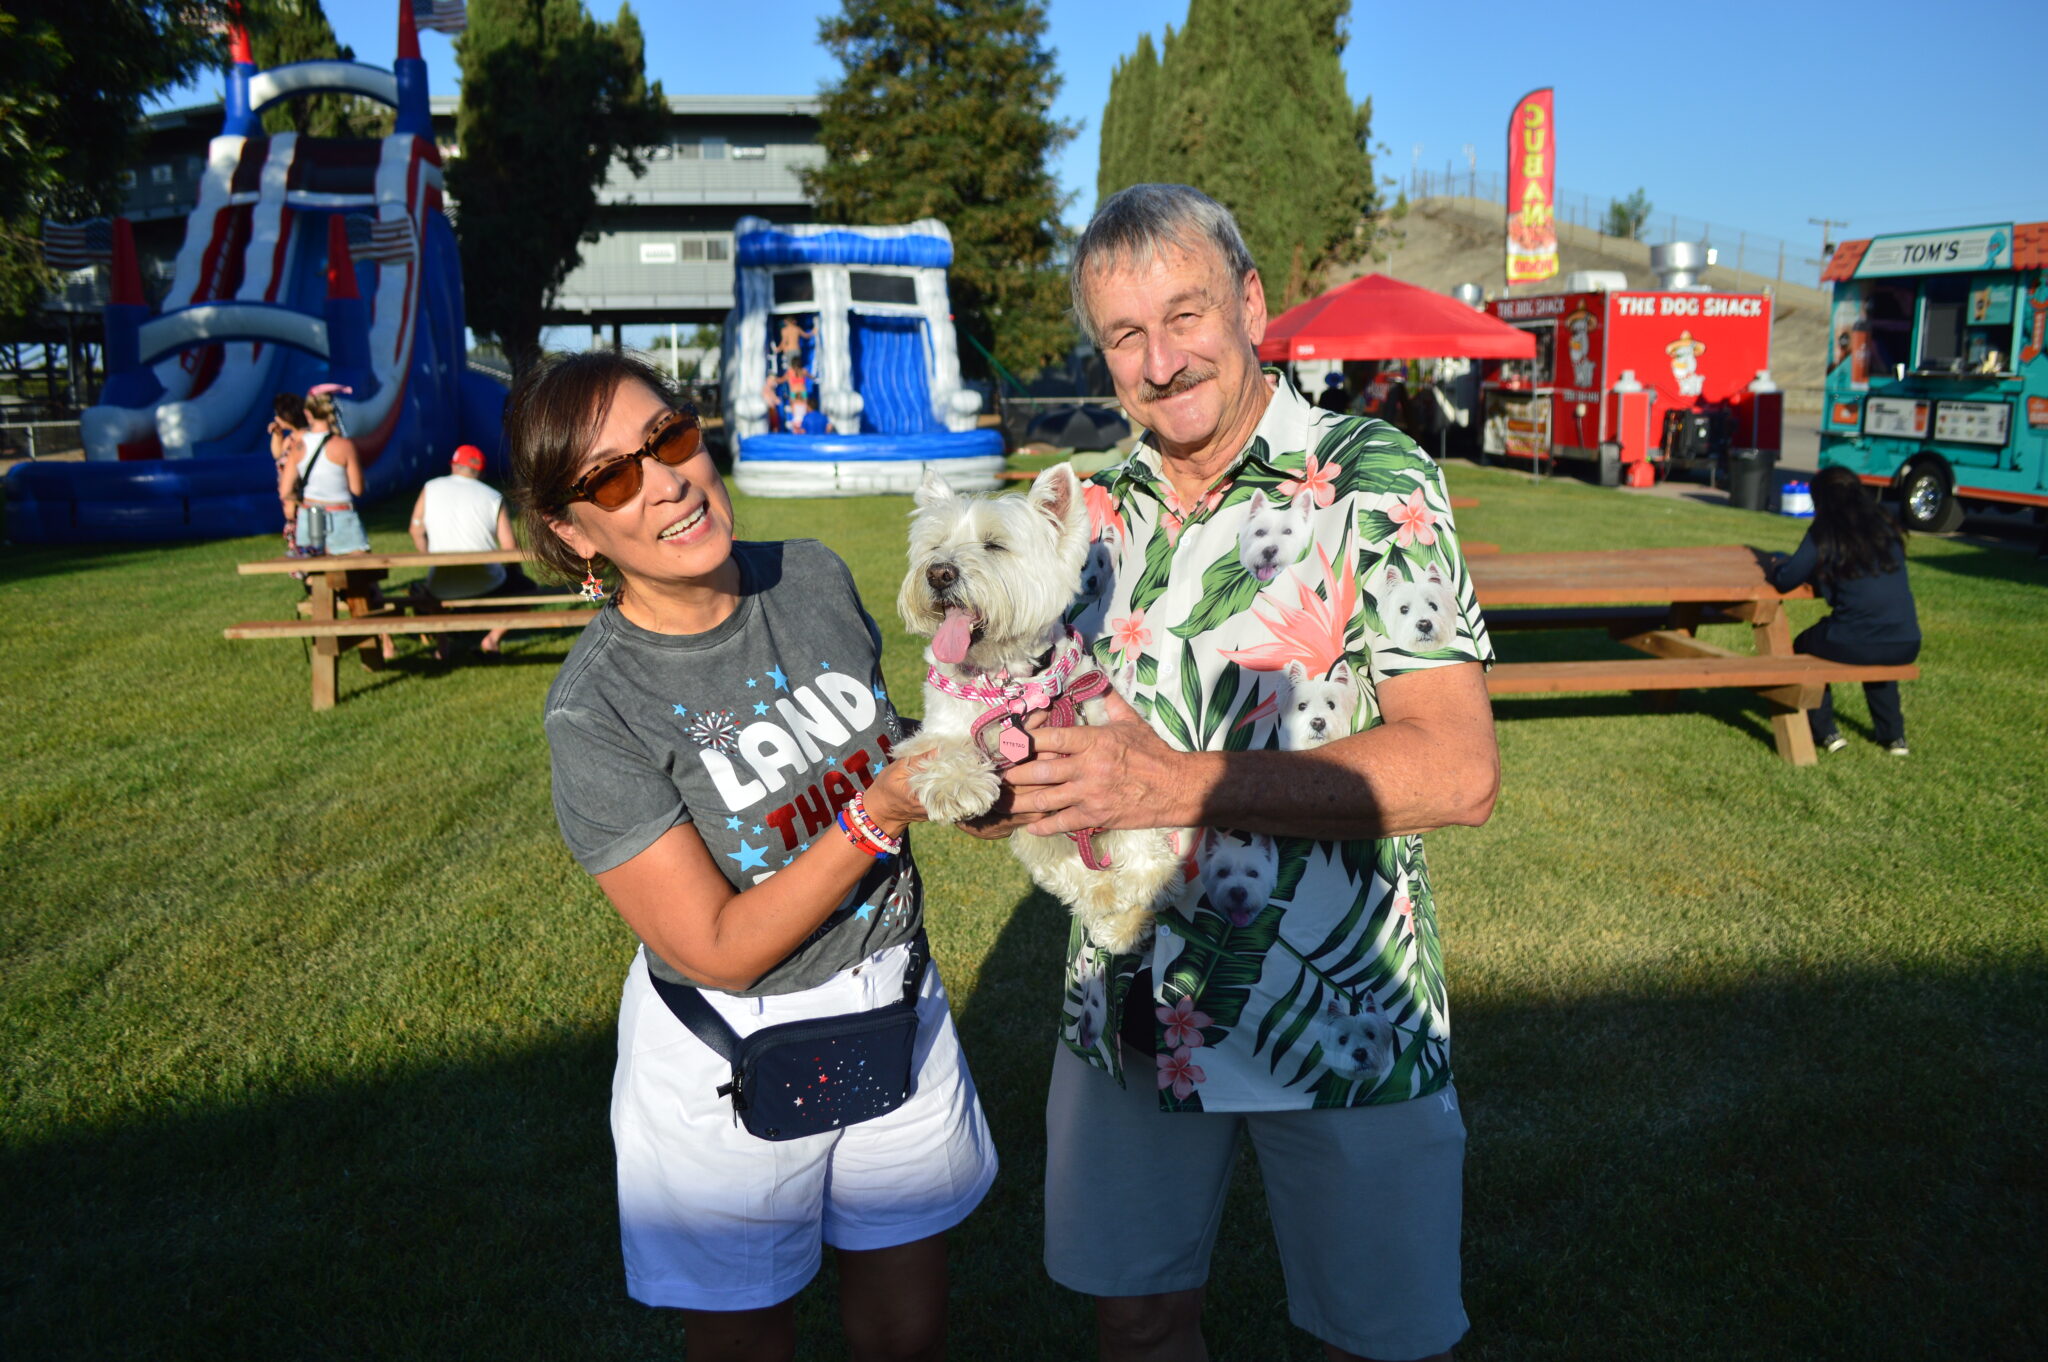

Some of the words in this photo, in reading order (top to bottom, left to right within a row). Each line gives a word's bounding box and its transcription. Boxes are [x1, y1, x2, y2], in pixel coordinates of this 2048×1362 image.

[1903, 240, 1960, 265] TOM'S
[1618, 297, 1655, 316] THE
[1660, 297, 1699, 316] DOG
[1703, 298, 1761, 317] SHACK
[699, 672, 876, 812] LAND
[765, 749, 875, 851] THAT
